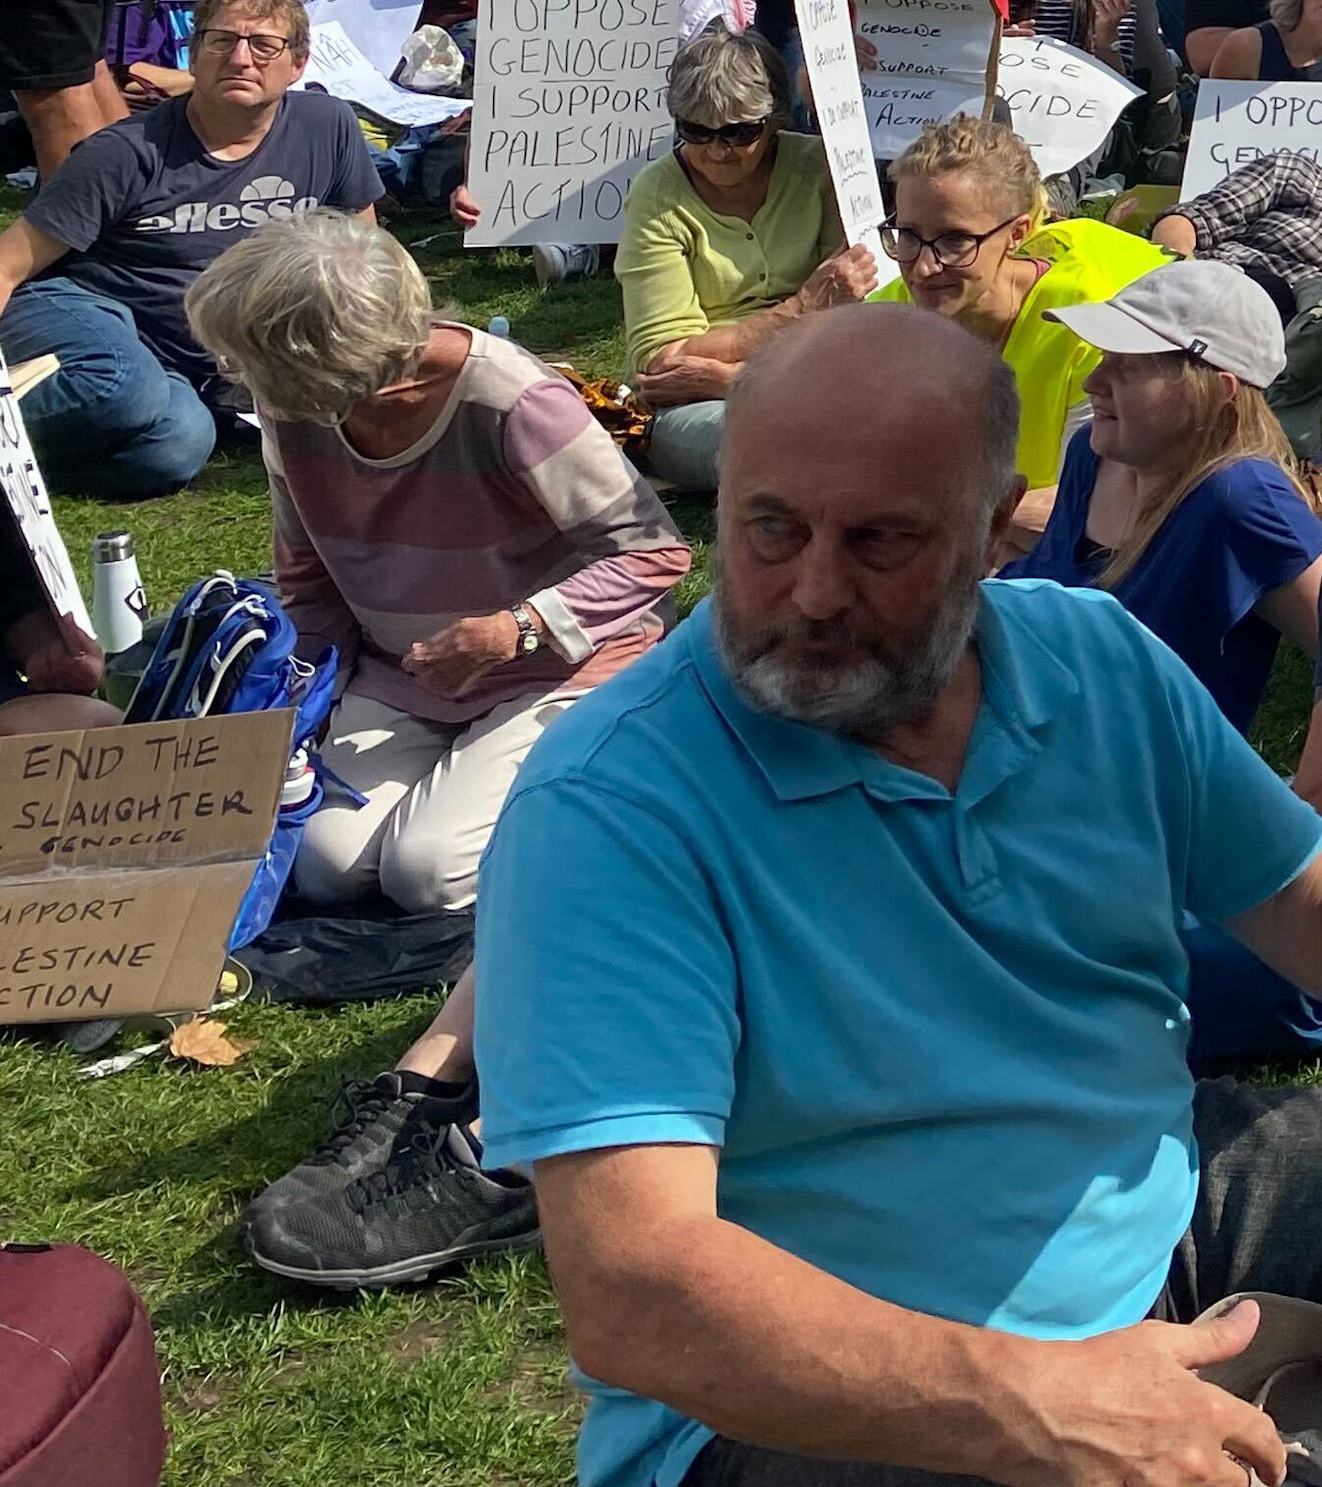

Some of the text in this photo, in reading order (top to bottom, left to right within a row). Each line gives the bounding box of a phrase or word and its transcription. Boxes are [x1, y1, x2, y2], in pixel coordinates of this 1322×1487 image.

[489, 37, 677, 77] GENOCIDE
[878, 59, 949, 76] SUPPORT
[999, 53, 1082, 78] OSE
[492, 85, 497, 119] I
[510, 85, 670, 118] SUPPORT
[874, 103, 942, 129] ACTION
[1007, 89, 1099, 118] CIDE
[1215, 95, 1220, 123] I
[485, 121, 671, 172] PALESTINE
[22, 735, 220, 781] END THE
[12, 790, 253, 830] SLAUGHTER
[40, 828, 187, 853] GENOCIDE
[0, 898, 135, 925] UPPORT
[12, 942, 156, 974] ESTINE
[0, 982, 113, 1009] CTION
